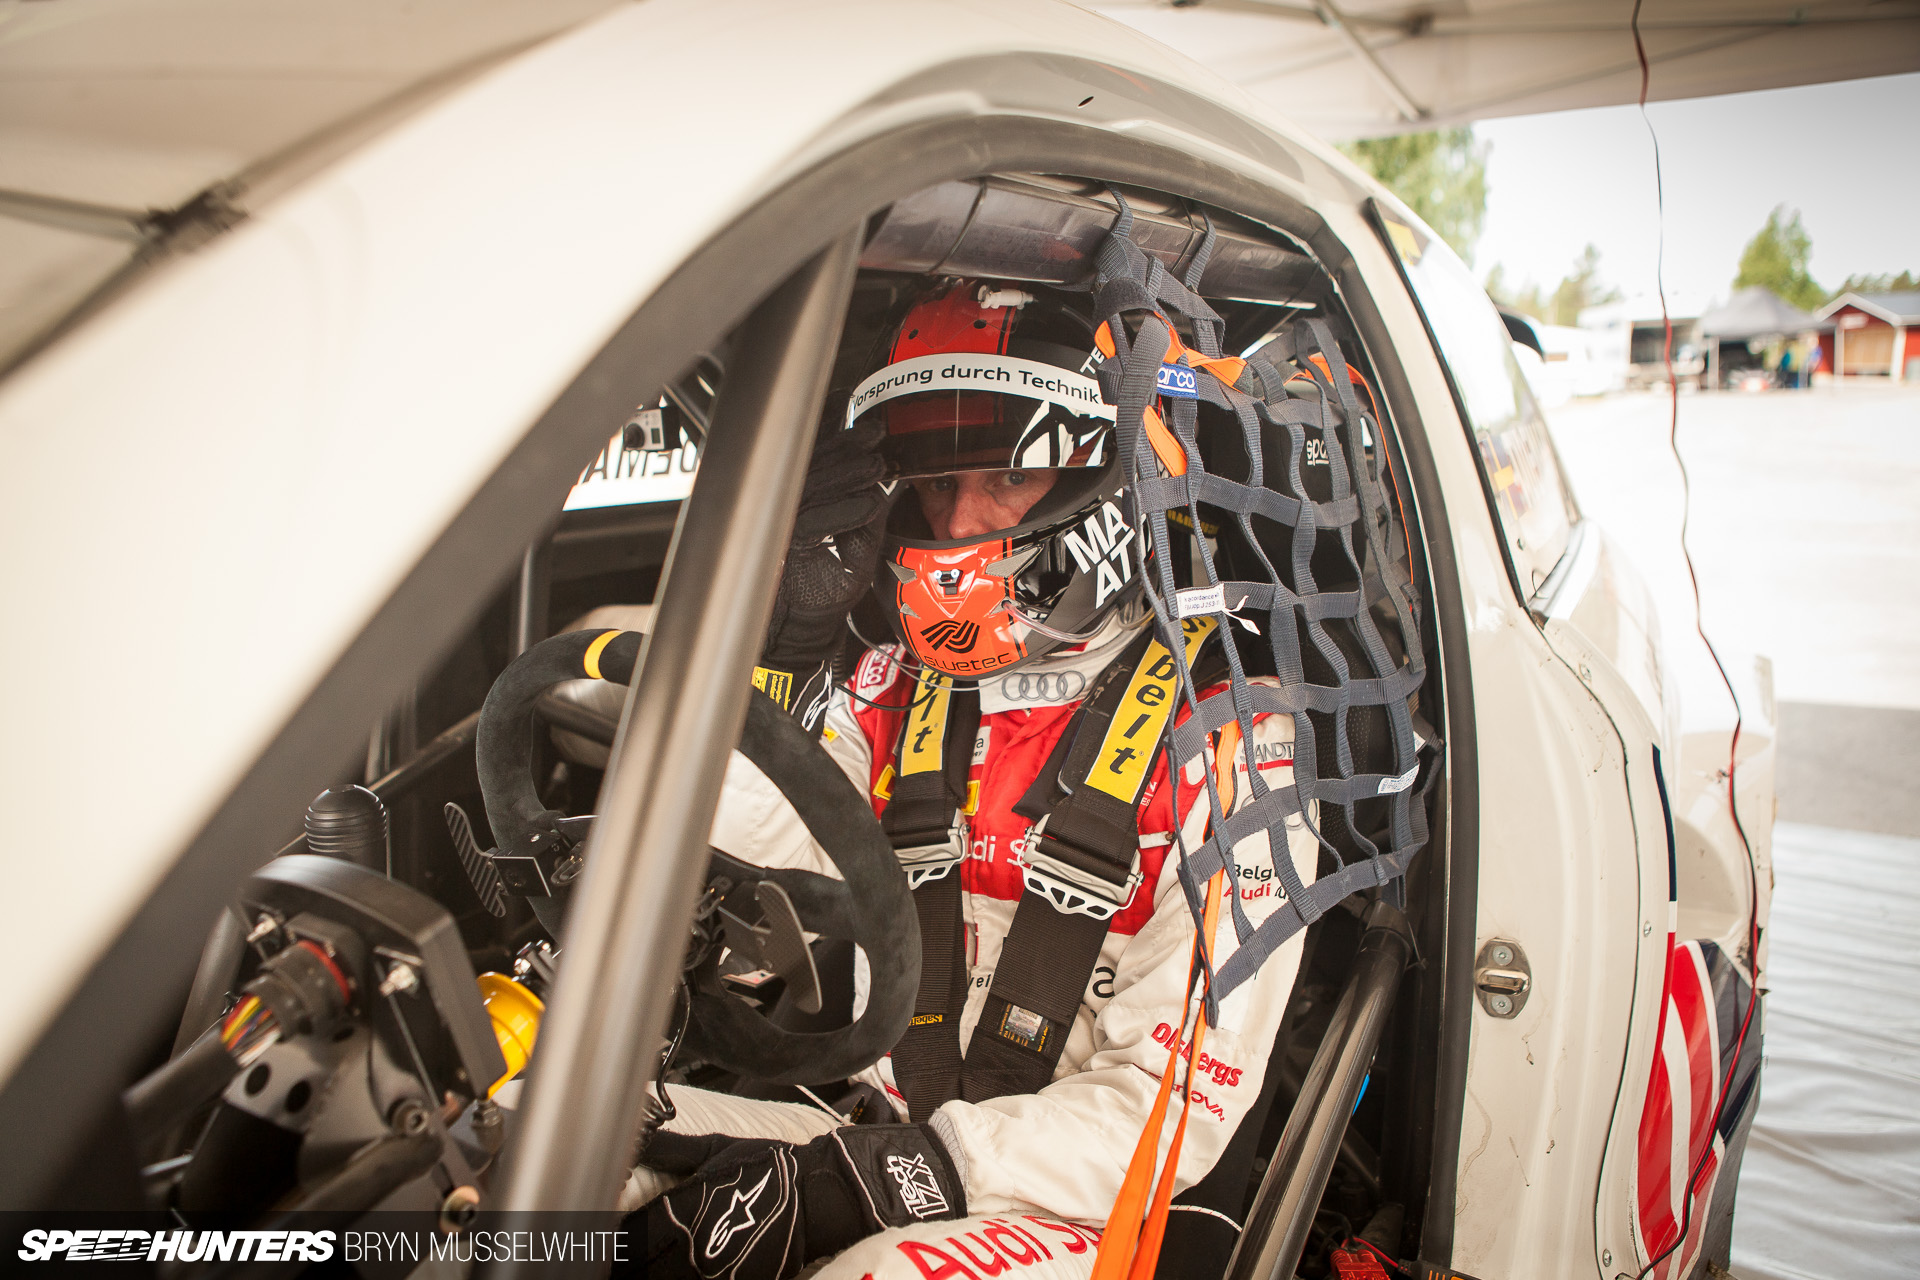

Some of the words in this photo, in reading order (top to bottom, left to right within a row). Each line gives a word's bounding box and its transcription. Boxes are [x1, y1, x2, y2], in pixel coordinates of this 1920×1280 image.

[941, 364, 1010, 382] durch
[1018, 370, 1100, 404] Technik
[1157, 367, 1196, 388] arco
[1063, 488, 1131, 575] MA
[896, 1218, 1053, 1280] Audi
